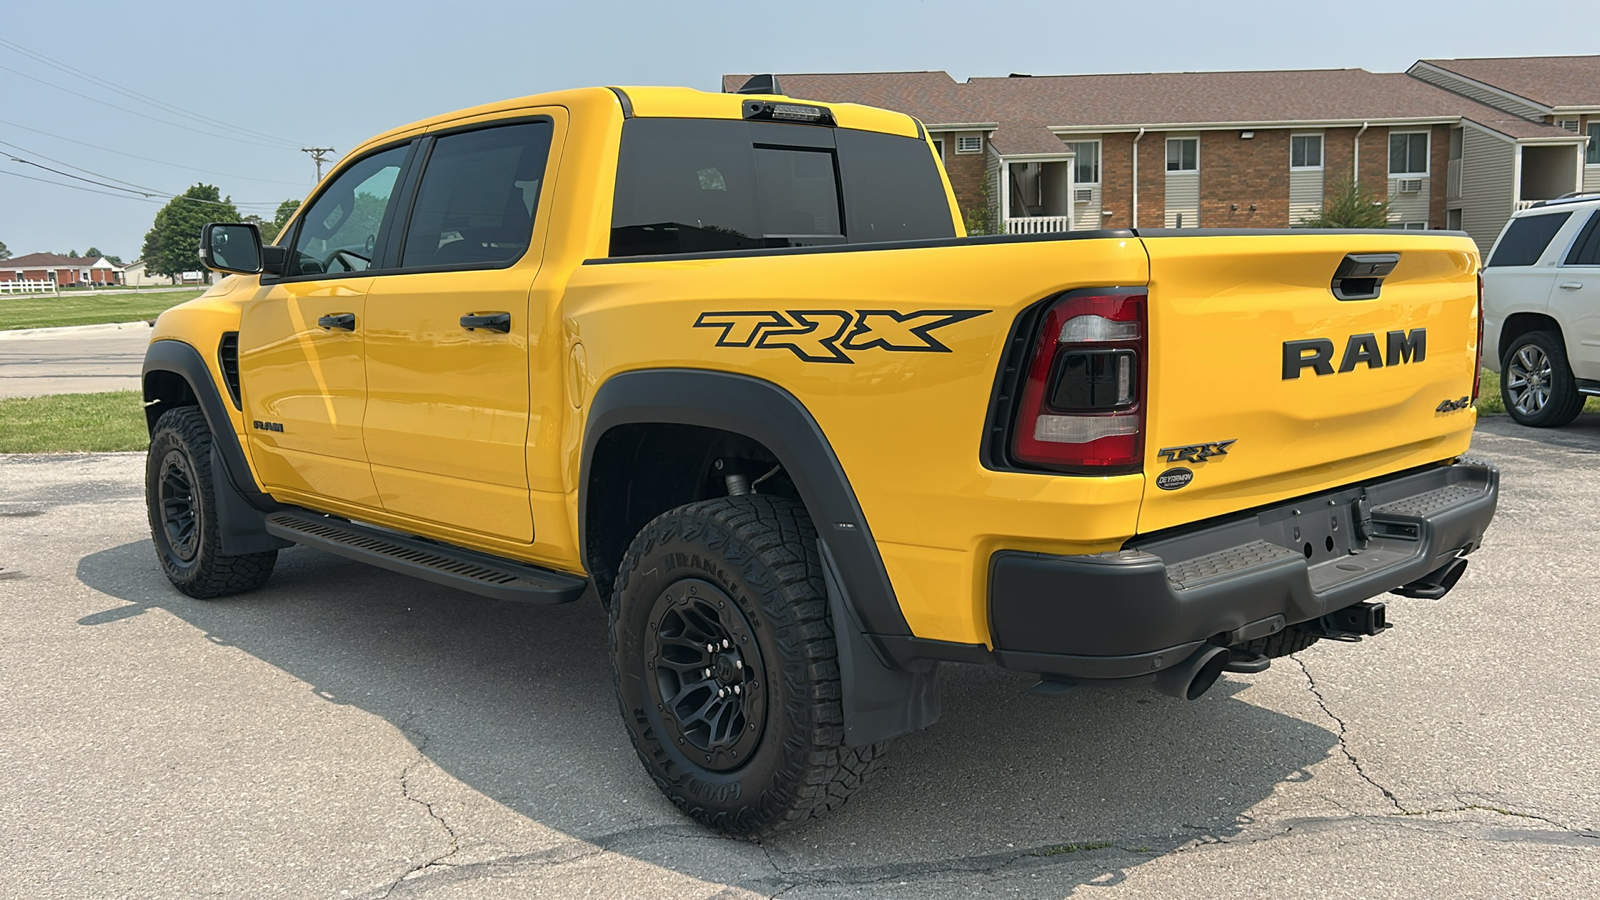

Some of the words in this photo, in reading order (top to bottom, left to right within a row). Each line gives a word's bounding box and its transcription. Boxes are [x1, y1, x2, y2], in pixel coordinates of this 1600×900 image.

[693, 309, 993, 364] TRX
[1282, 327, 1427, 380] RAM
[1436, 395, 1469, 413] 4x4
[253, 420, 284, 433] RAM
[1156, 438, 1238, 463] TRX
